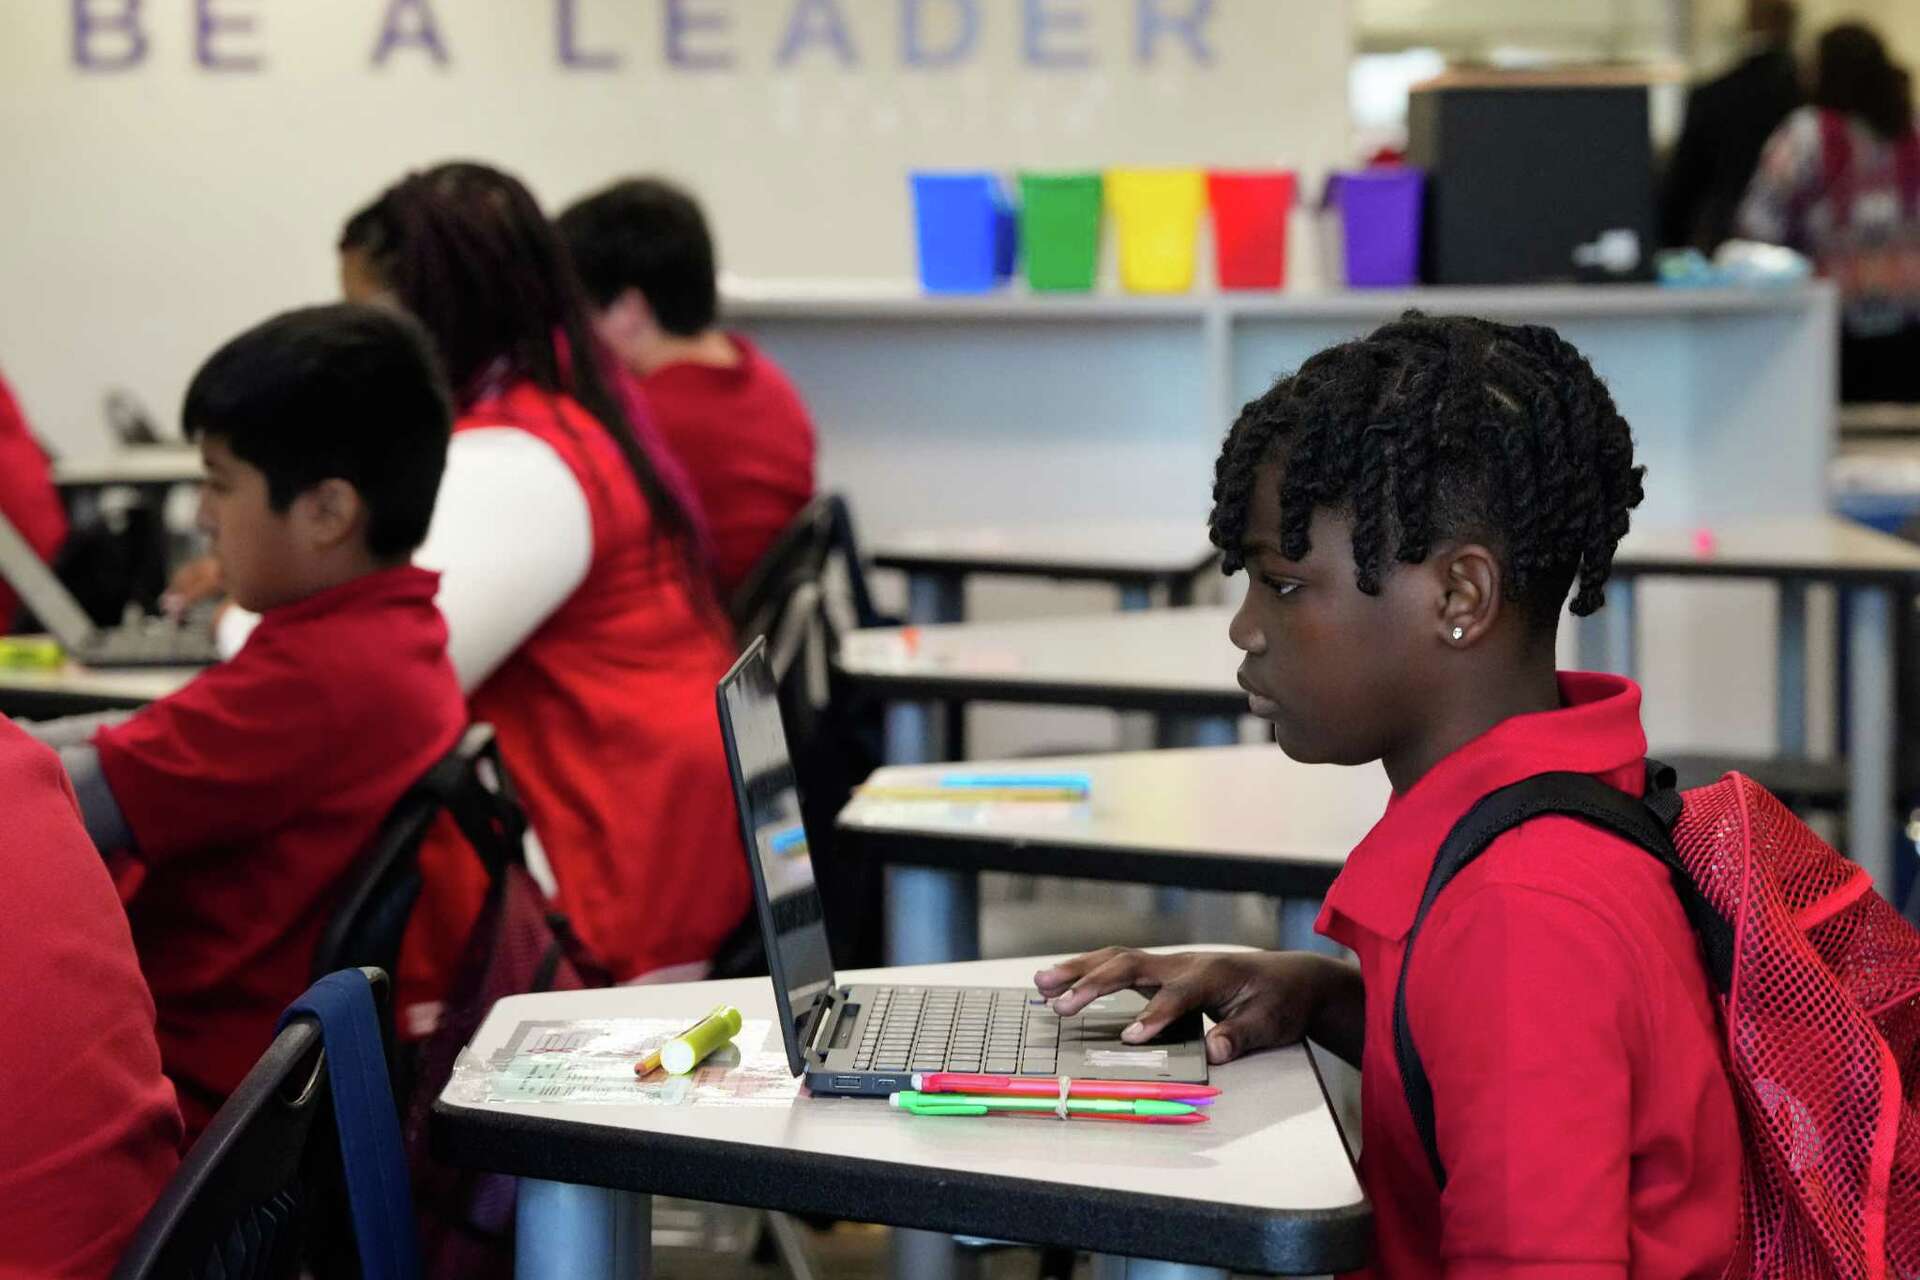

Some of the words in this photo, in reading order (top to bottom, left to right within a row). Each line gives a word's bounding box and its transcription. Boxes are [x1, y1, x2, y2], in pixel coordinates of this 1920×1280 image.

[71, 0, 266, 72] BE
[370, 0, 451, 70] A
[554, 0, 1216, 70] LEADER
